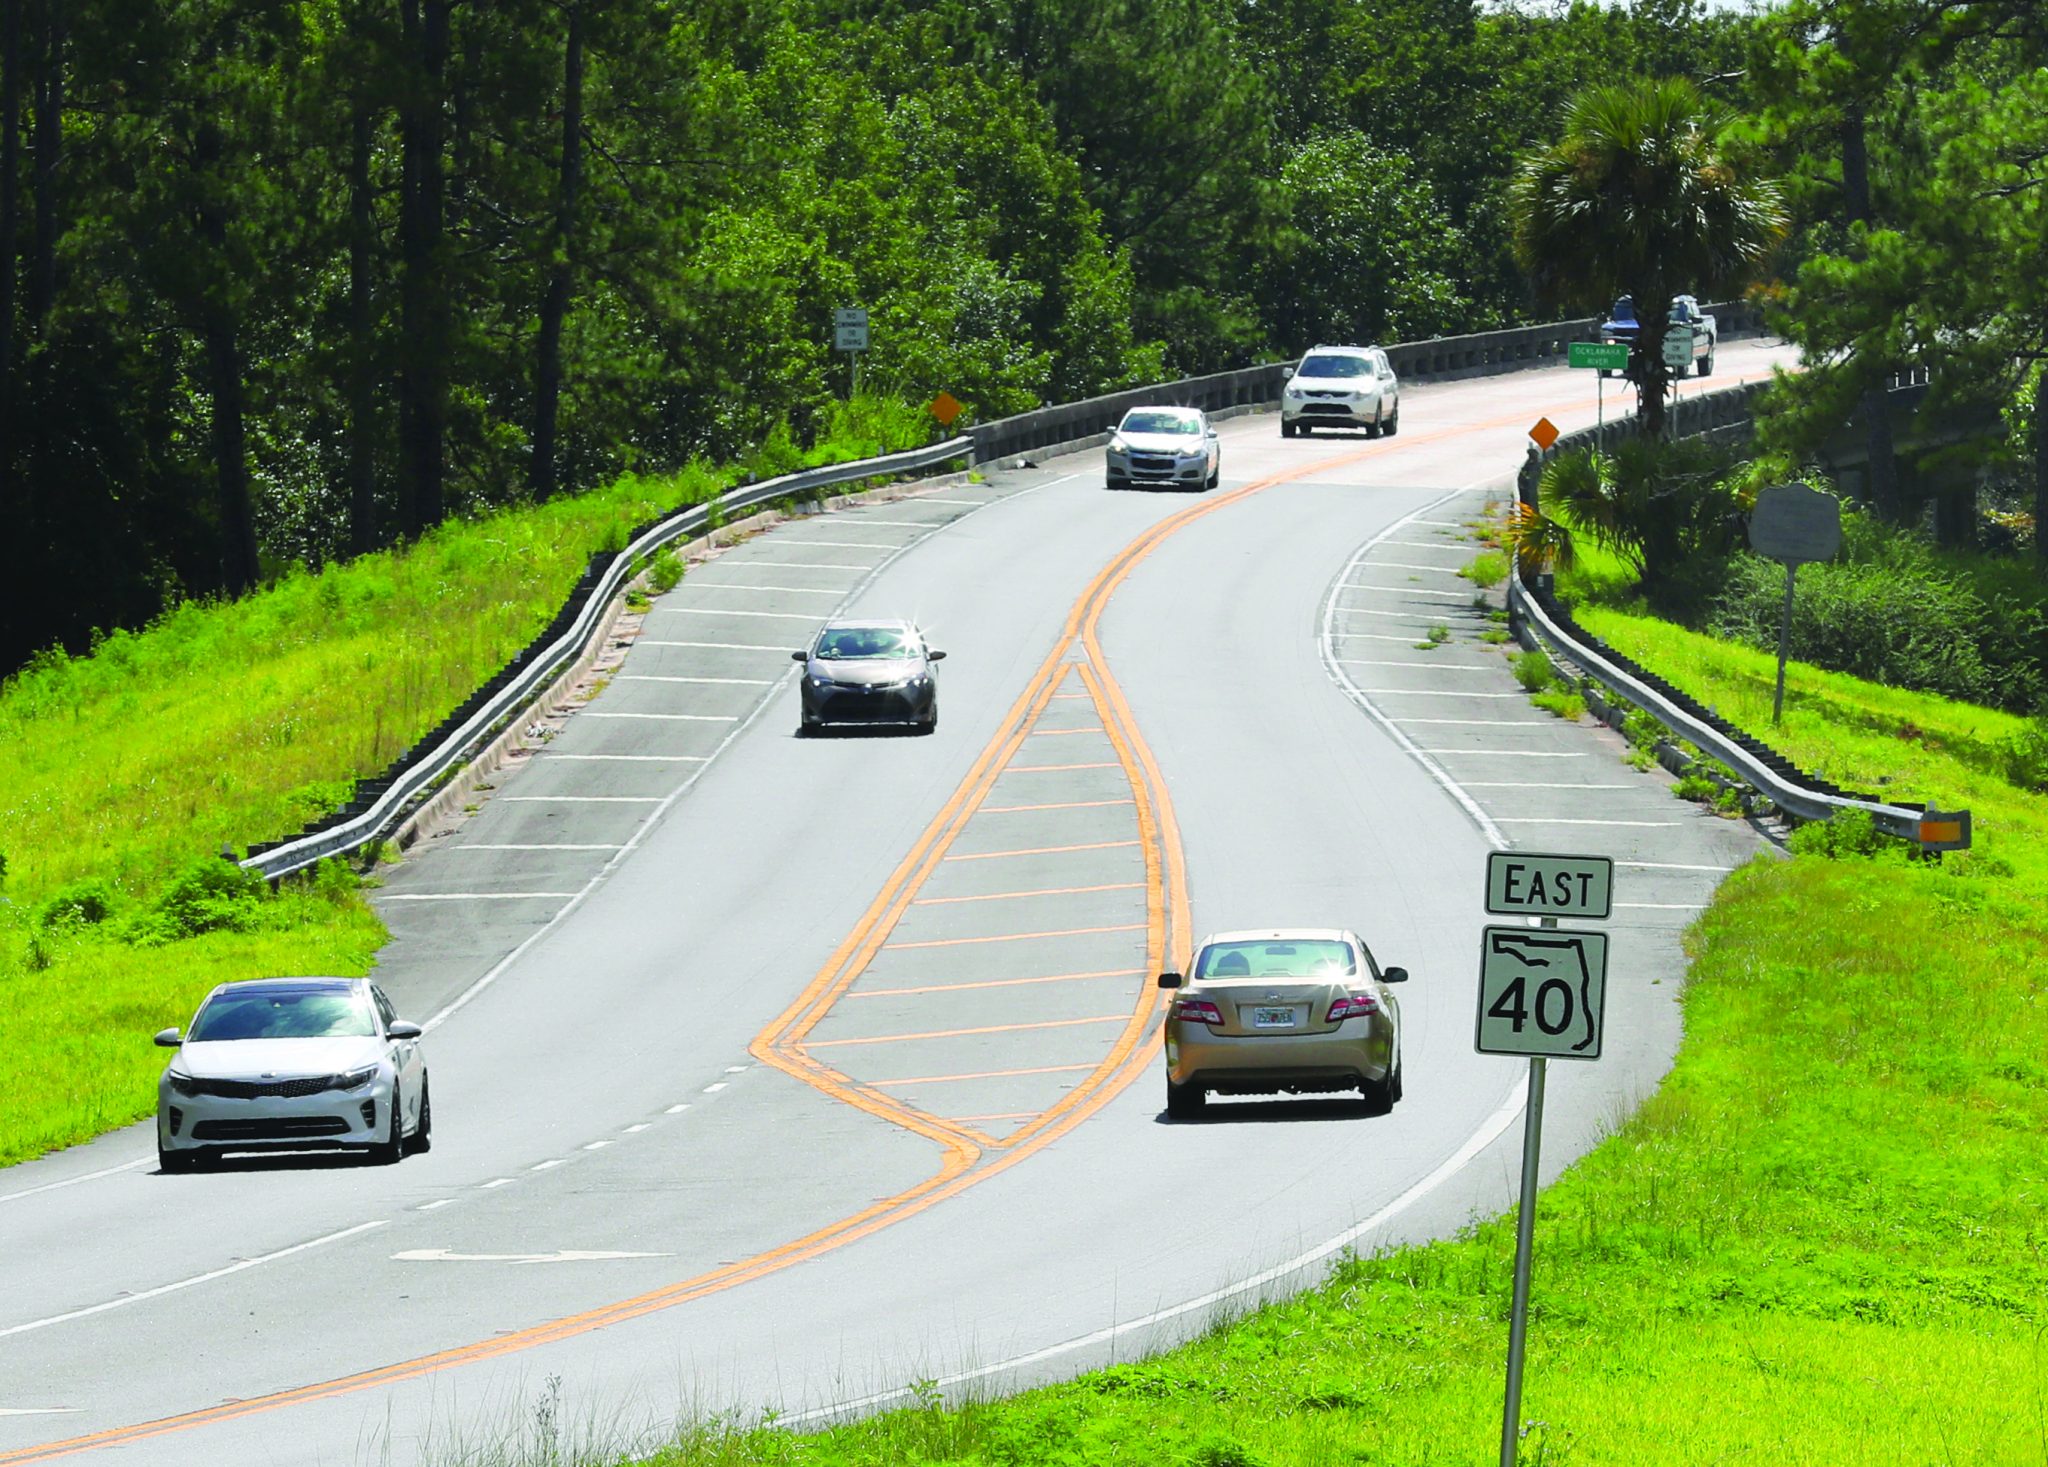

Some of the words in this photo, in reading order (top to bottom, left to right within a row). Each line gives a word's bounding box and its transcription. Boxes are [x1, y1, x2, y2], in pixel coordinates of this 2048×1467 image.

[1587, 357, 1609, 366] RIVER
[1504, 864, 1593, 907] EAST
[1488, 977, 1574, 1035] 40
